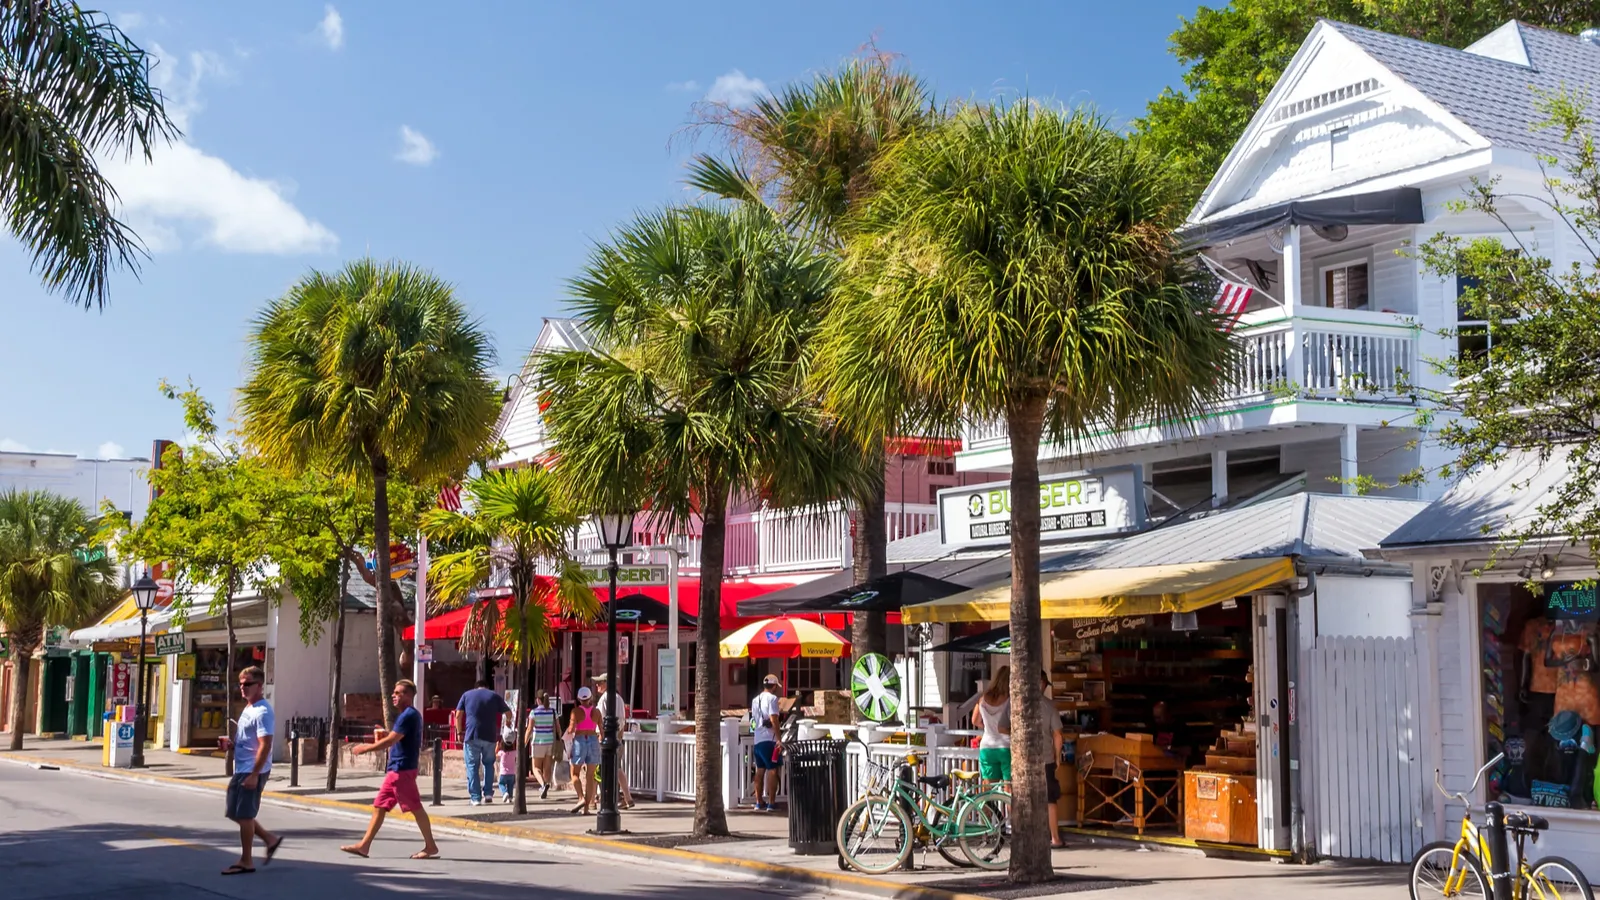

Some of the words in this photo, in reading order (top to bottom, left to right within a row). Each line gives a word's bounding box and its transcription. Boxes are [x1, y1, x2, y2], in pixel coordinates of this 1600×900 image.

[988, 476, 1105, 515] BUGERFI
[1060, 514, 1073, 529] CRAFT
[1074, 512, 1088, 528] BEERS
[1548, 590, 1596, 608] ATM
[157, 633, 183, 648] ATM
